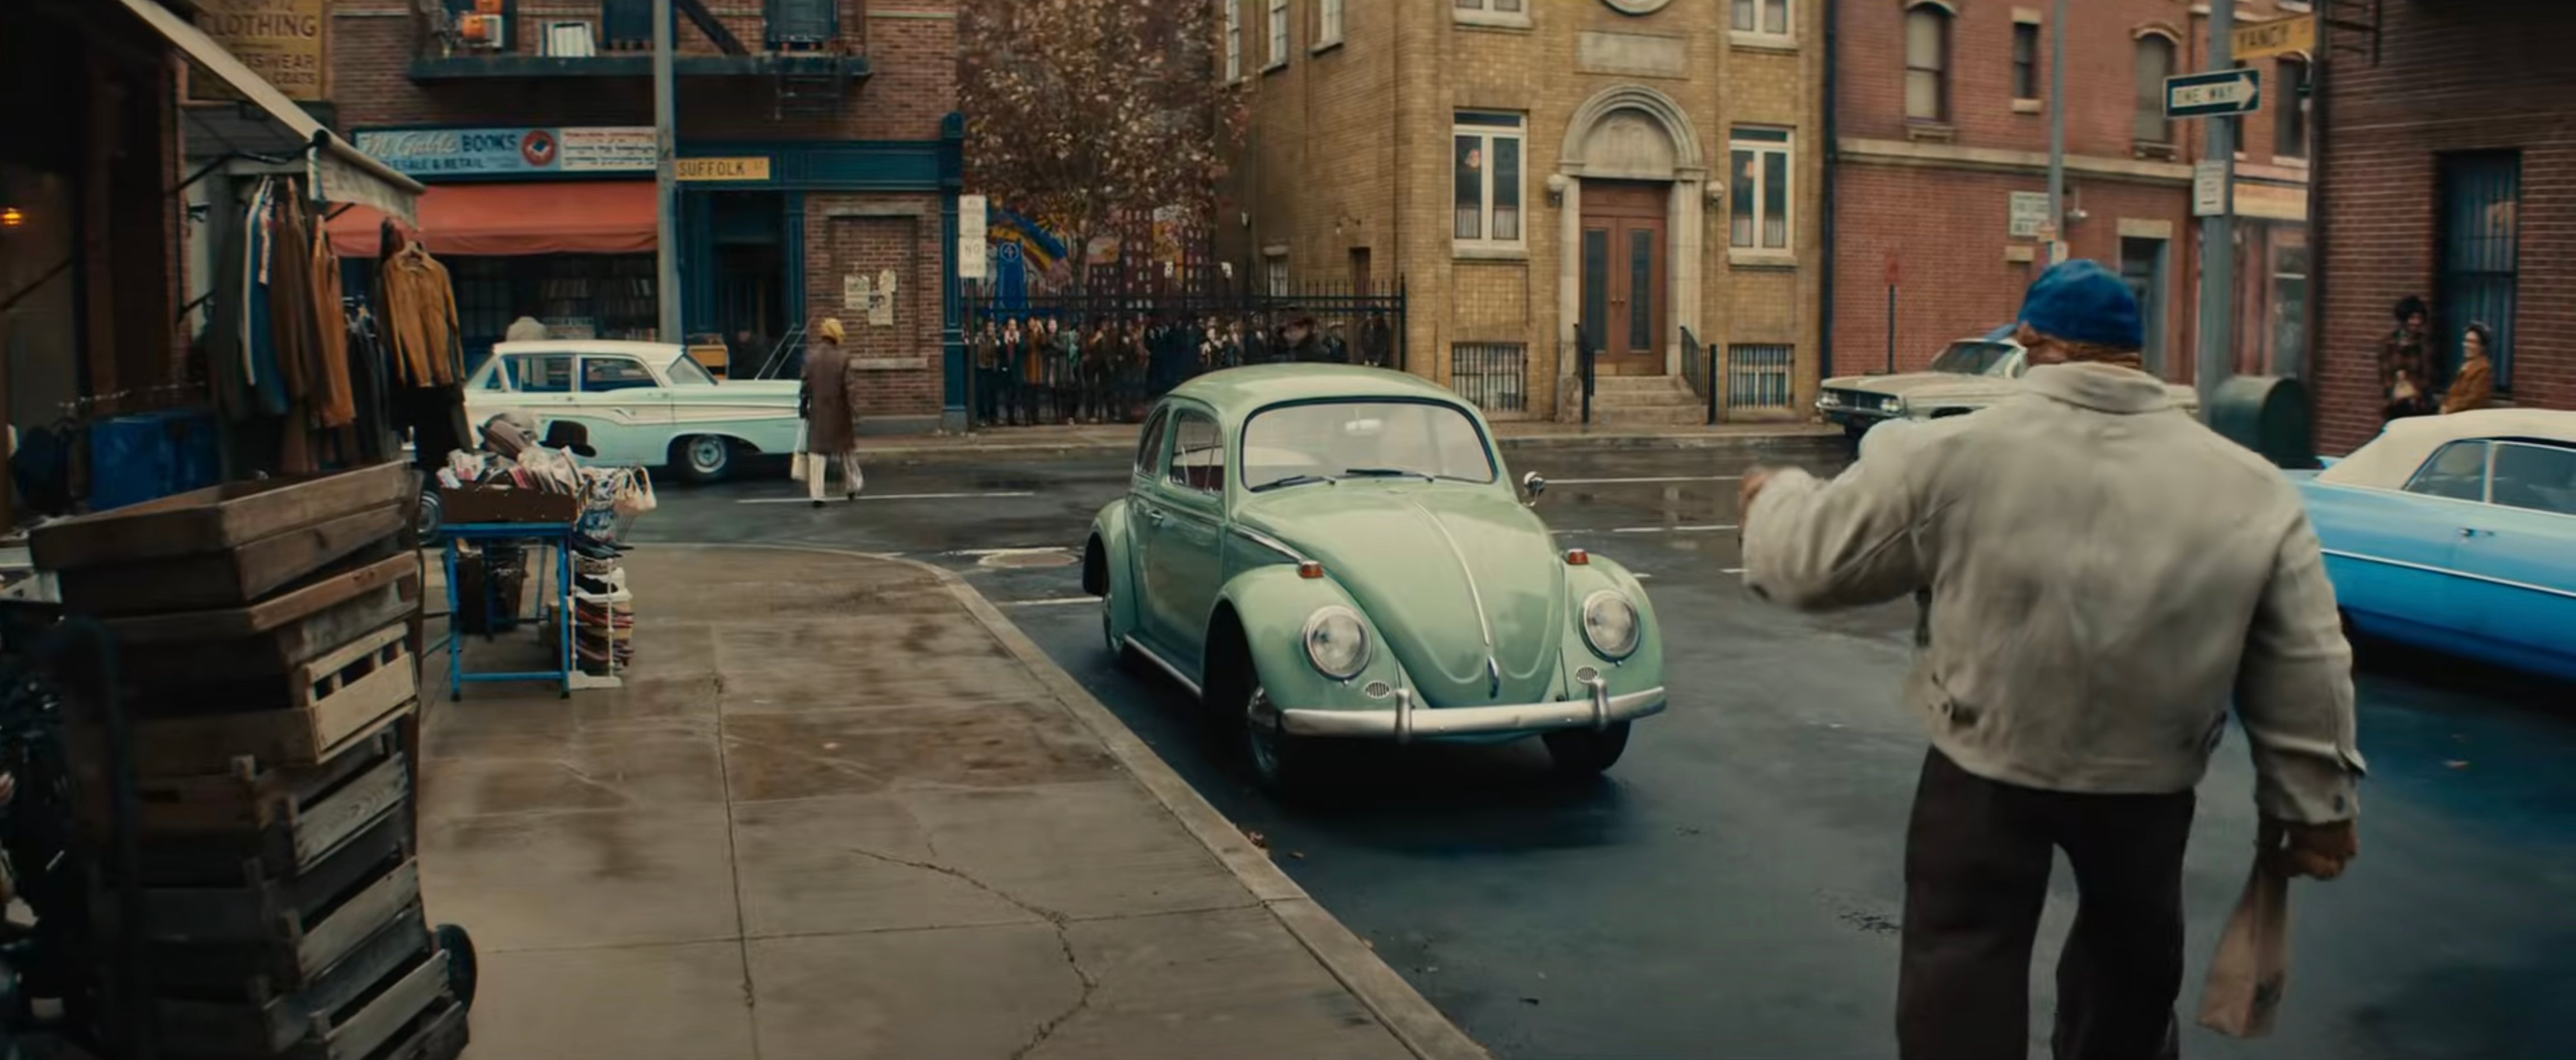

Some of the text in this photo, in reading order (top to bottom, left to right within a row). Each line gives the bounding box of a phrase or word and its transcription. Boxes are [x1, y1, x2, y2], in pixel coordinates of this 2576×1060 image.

[198, 13, 317, 37] CLOTHING
[2238, 24, 2289, 51] YANCY
[235, 53, 317, 68] TSWEAR
[2174, 85, 2234, 105] ONE WAY
[462, 134, 516, 152] BOOKS
[678, 161, 745, 177] SUFFOLK
